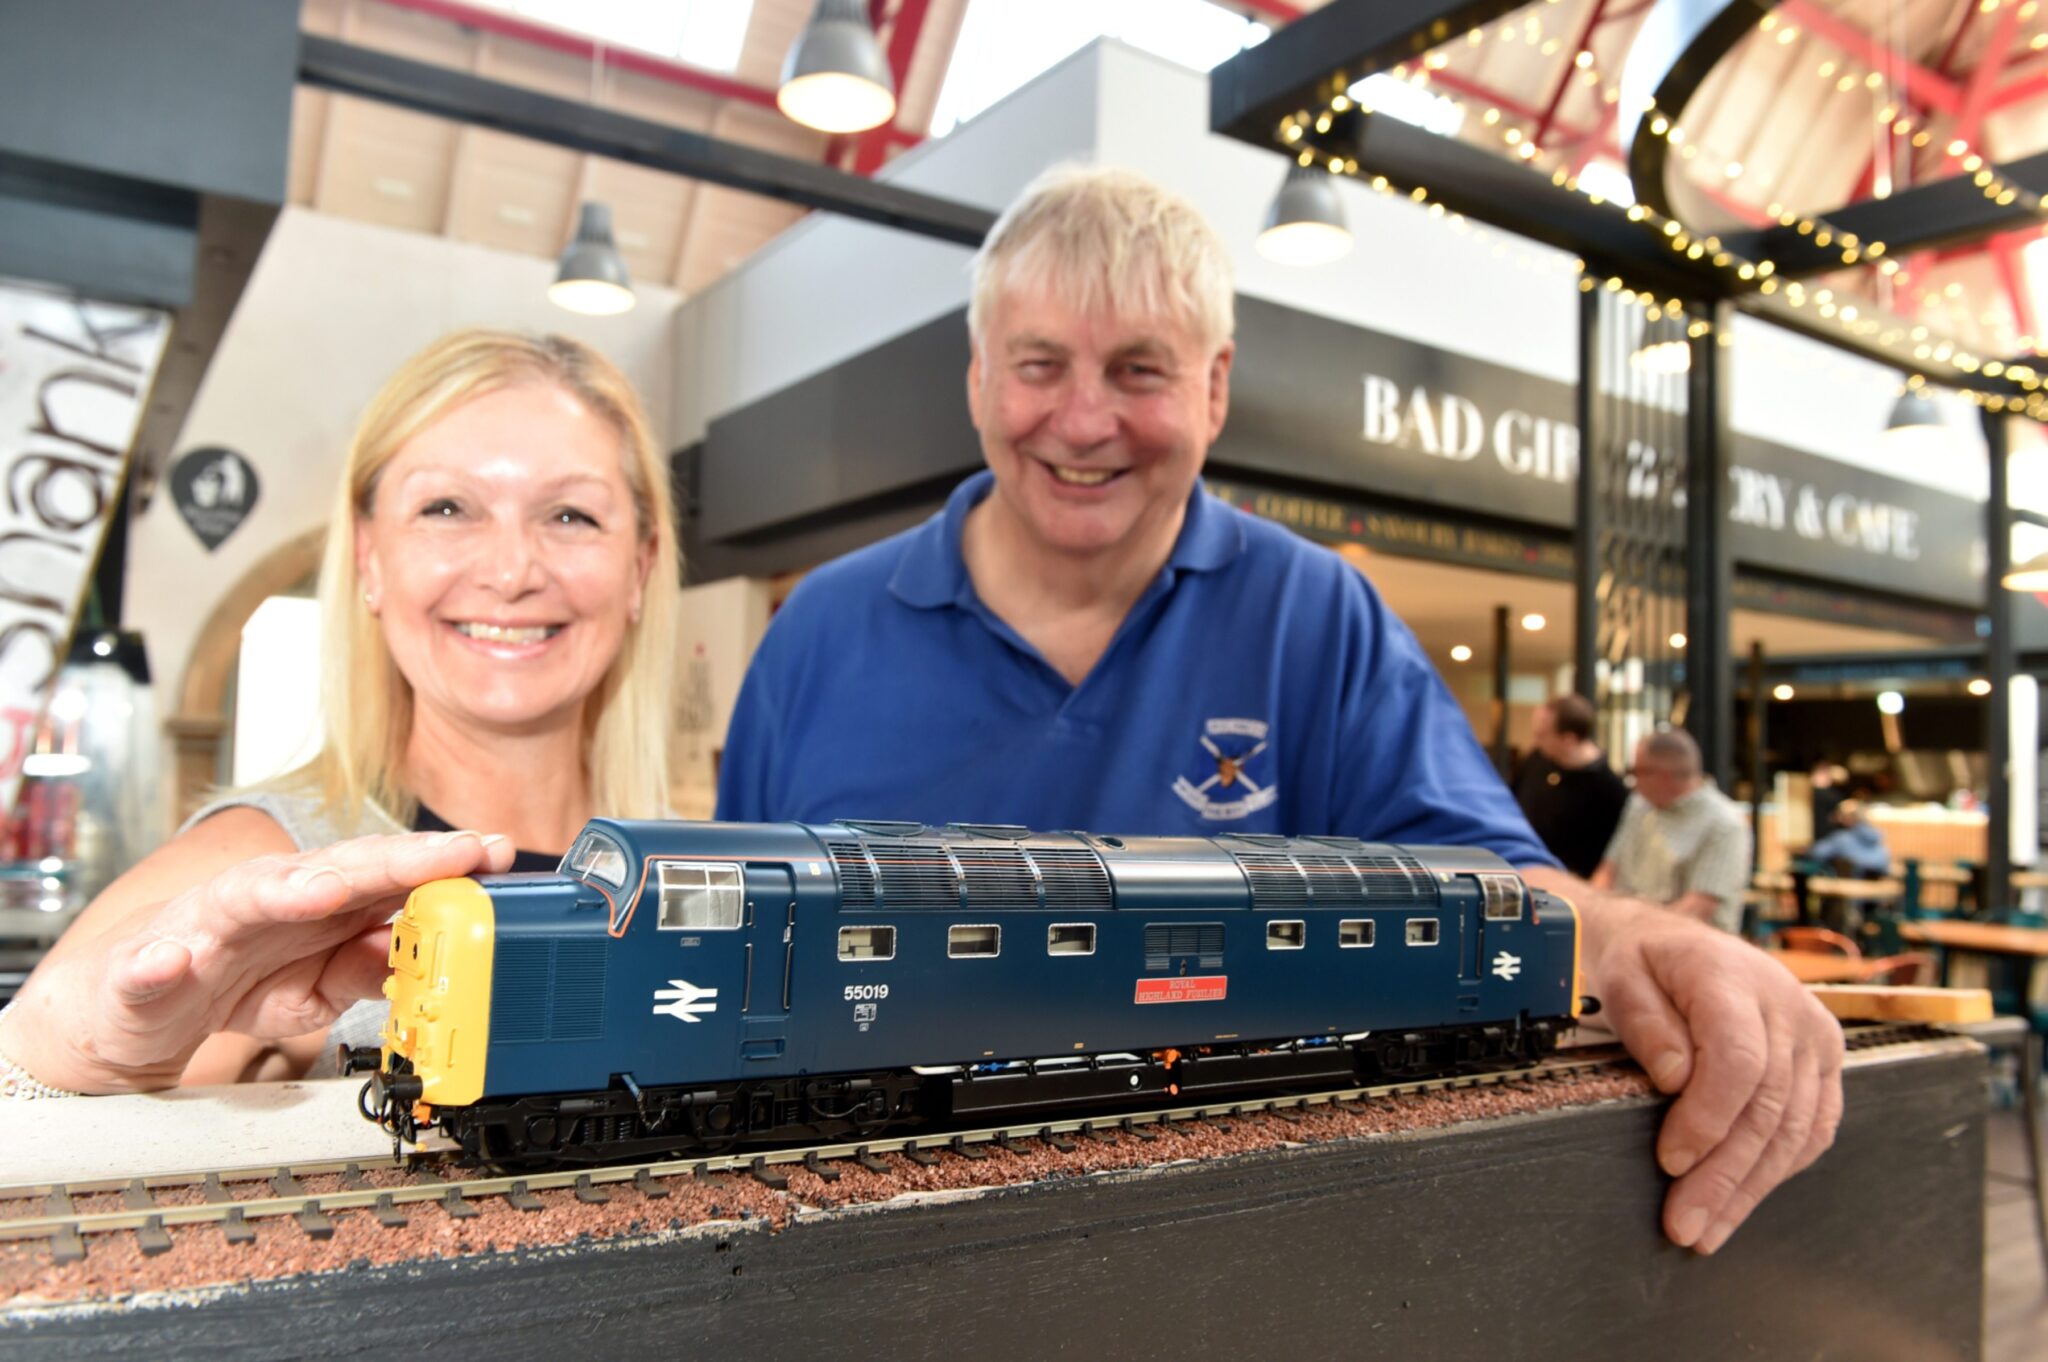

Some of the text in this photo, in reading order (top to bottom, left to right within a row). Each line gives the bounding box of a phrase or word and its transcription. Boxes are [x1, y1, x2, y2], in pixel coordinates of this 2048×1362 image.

[1362, 373, 1485, 462] BAD
[1492, 408, 1580, 485] GIR
[1795, 484, 1824, 541] &
[844, 984, 889, 1001] 55019
